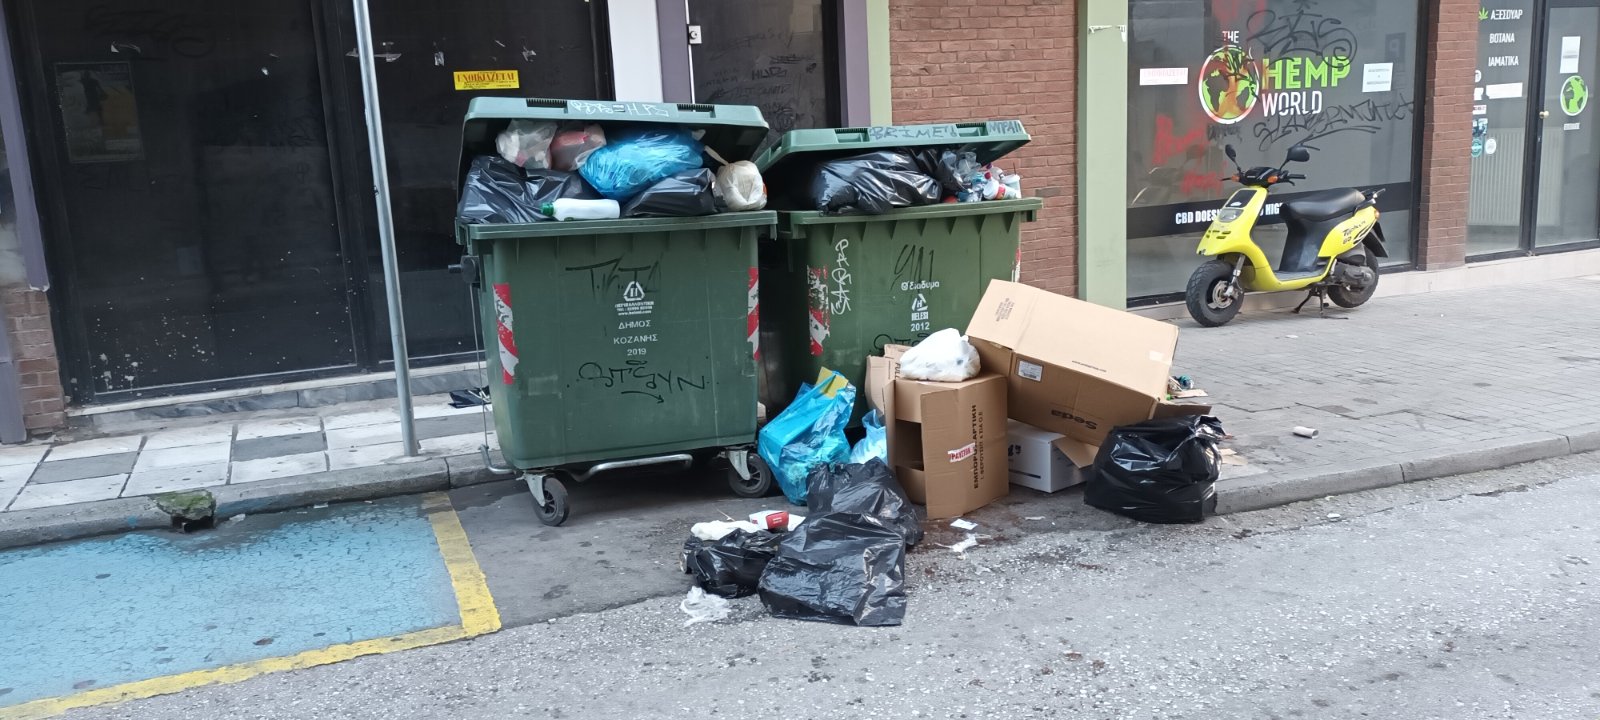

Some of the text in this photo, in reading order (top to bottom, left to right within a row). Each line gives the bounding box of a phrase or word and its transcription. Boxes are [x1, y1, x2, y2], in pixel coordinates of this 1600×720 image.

[1490, 9, 1523, 20] ΑΞΕΣΟΥΑΡ
[1221, 30, 1240, 43] THE
[1489, 32, 1515, 43] ΒΟΤΑΝΑ
[1488, 55, 1519, 66] ΙΑΜΑΤΙΚΑ
[1261, 55, 1351, 90] HEMP
[1261, 90, 1323, 117] WORLD
[1175, 212, 1194, 225] CBD
[618, 319, 651, 330] ΔΗΜΟΣ
[910, 321, 930, 332] 2012
[613, 333, 659, 345] ΚΟΖΑΝΗΣ
[626, 347, 647, 356] 2019
[1050, 409, 1098, 430] Seda
